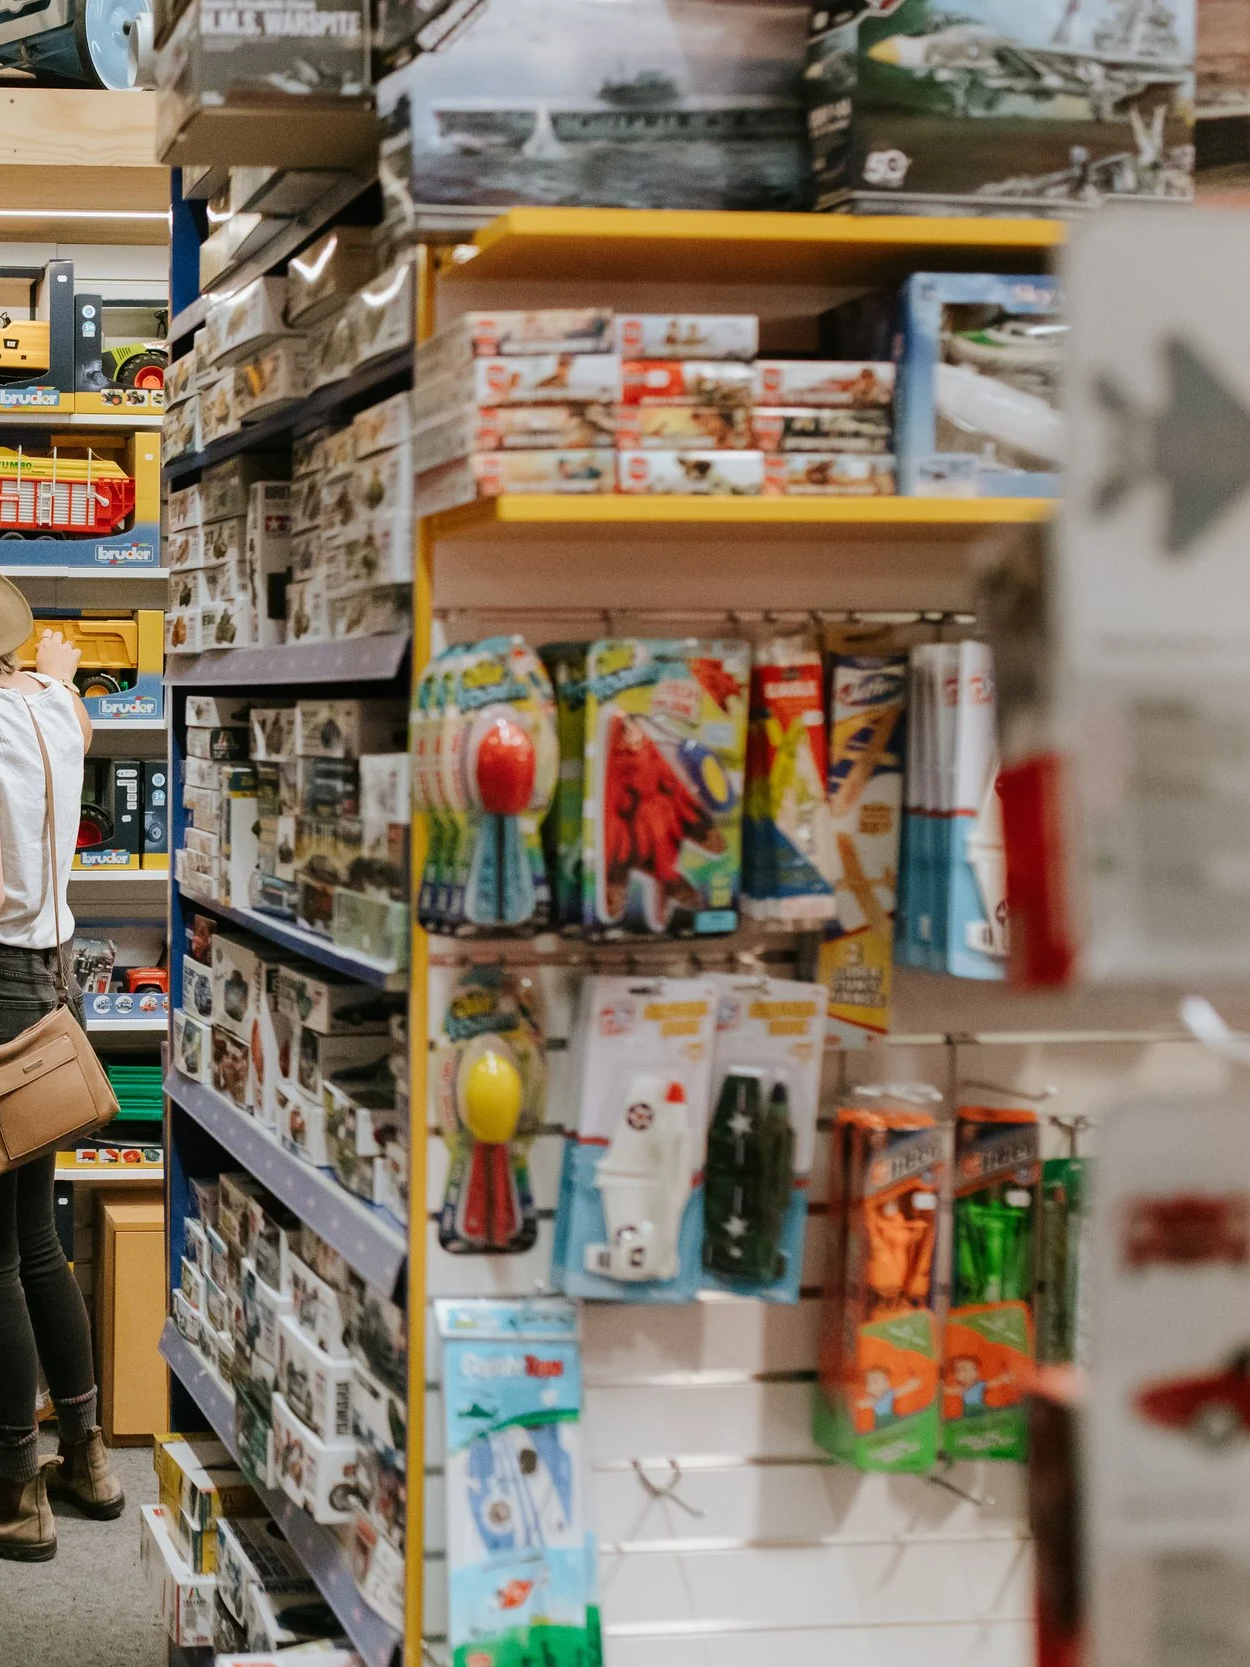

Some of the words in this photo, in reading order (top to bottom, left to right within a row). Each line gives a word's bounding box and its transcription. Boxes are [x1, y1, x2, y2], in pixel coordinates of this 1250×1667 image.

[0, 389, 58, 405] bruder
[98, 546, 150, 560] bruder
[101, 700, 155, 714] bruder
[81, 852, 129, 864] bruder
